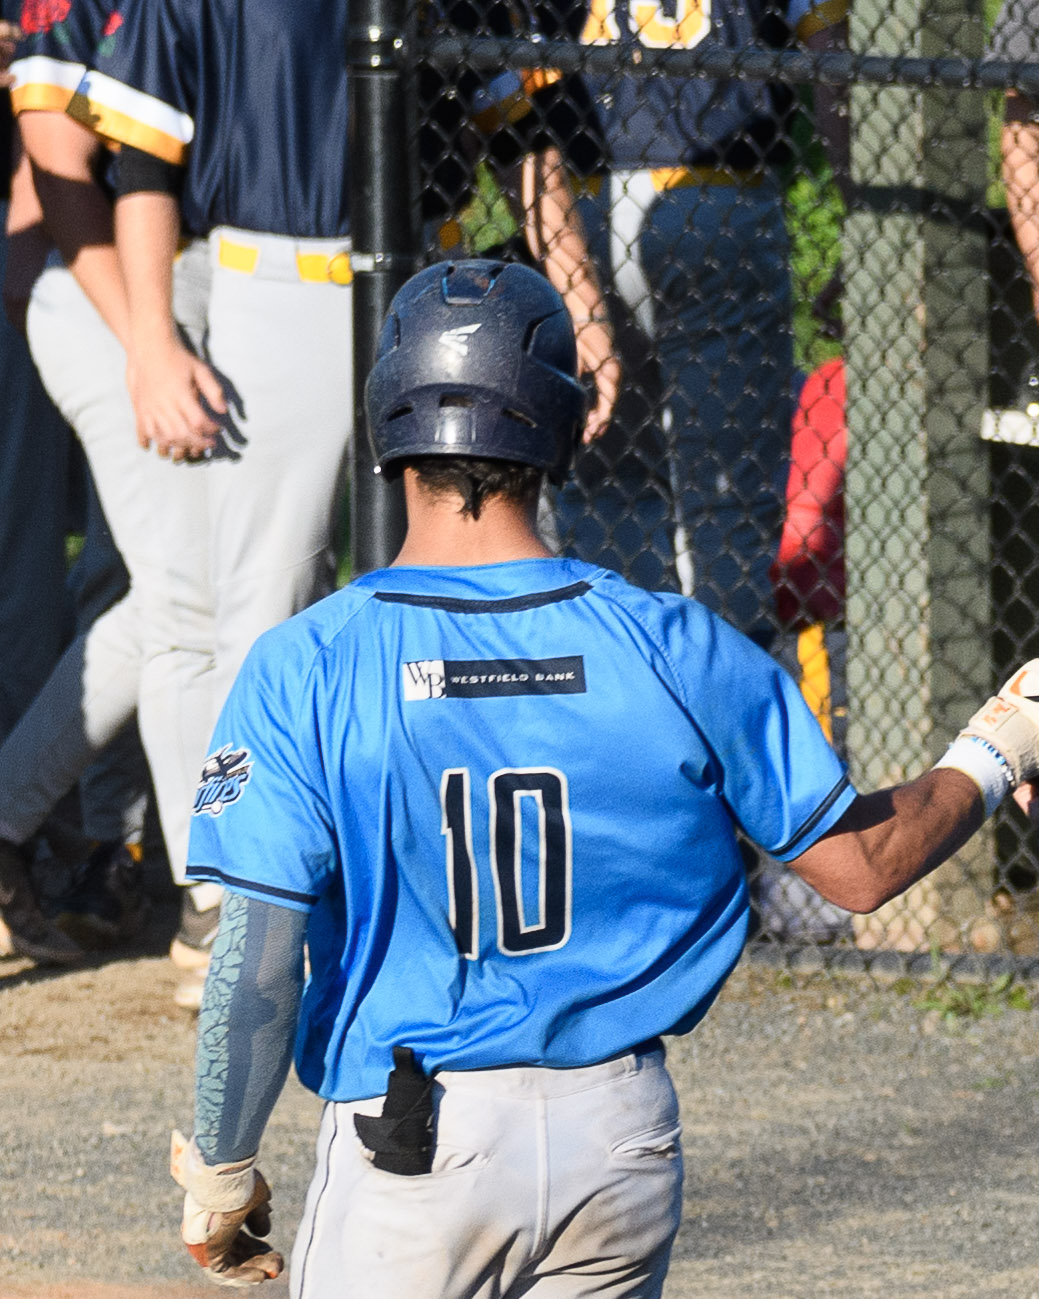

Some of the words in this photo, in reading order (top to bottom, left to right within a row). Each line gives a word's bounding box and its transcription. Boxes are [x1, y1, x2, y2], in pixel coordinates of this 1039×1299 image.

[450, 673, 529, 684] WESTFIELD
[535, 671, 576, 682] BANK
[440, 767, 572, 961] 10
